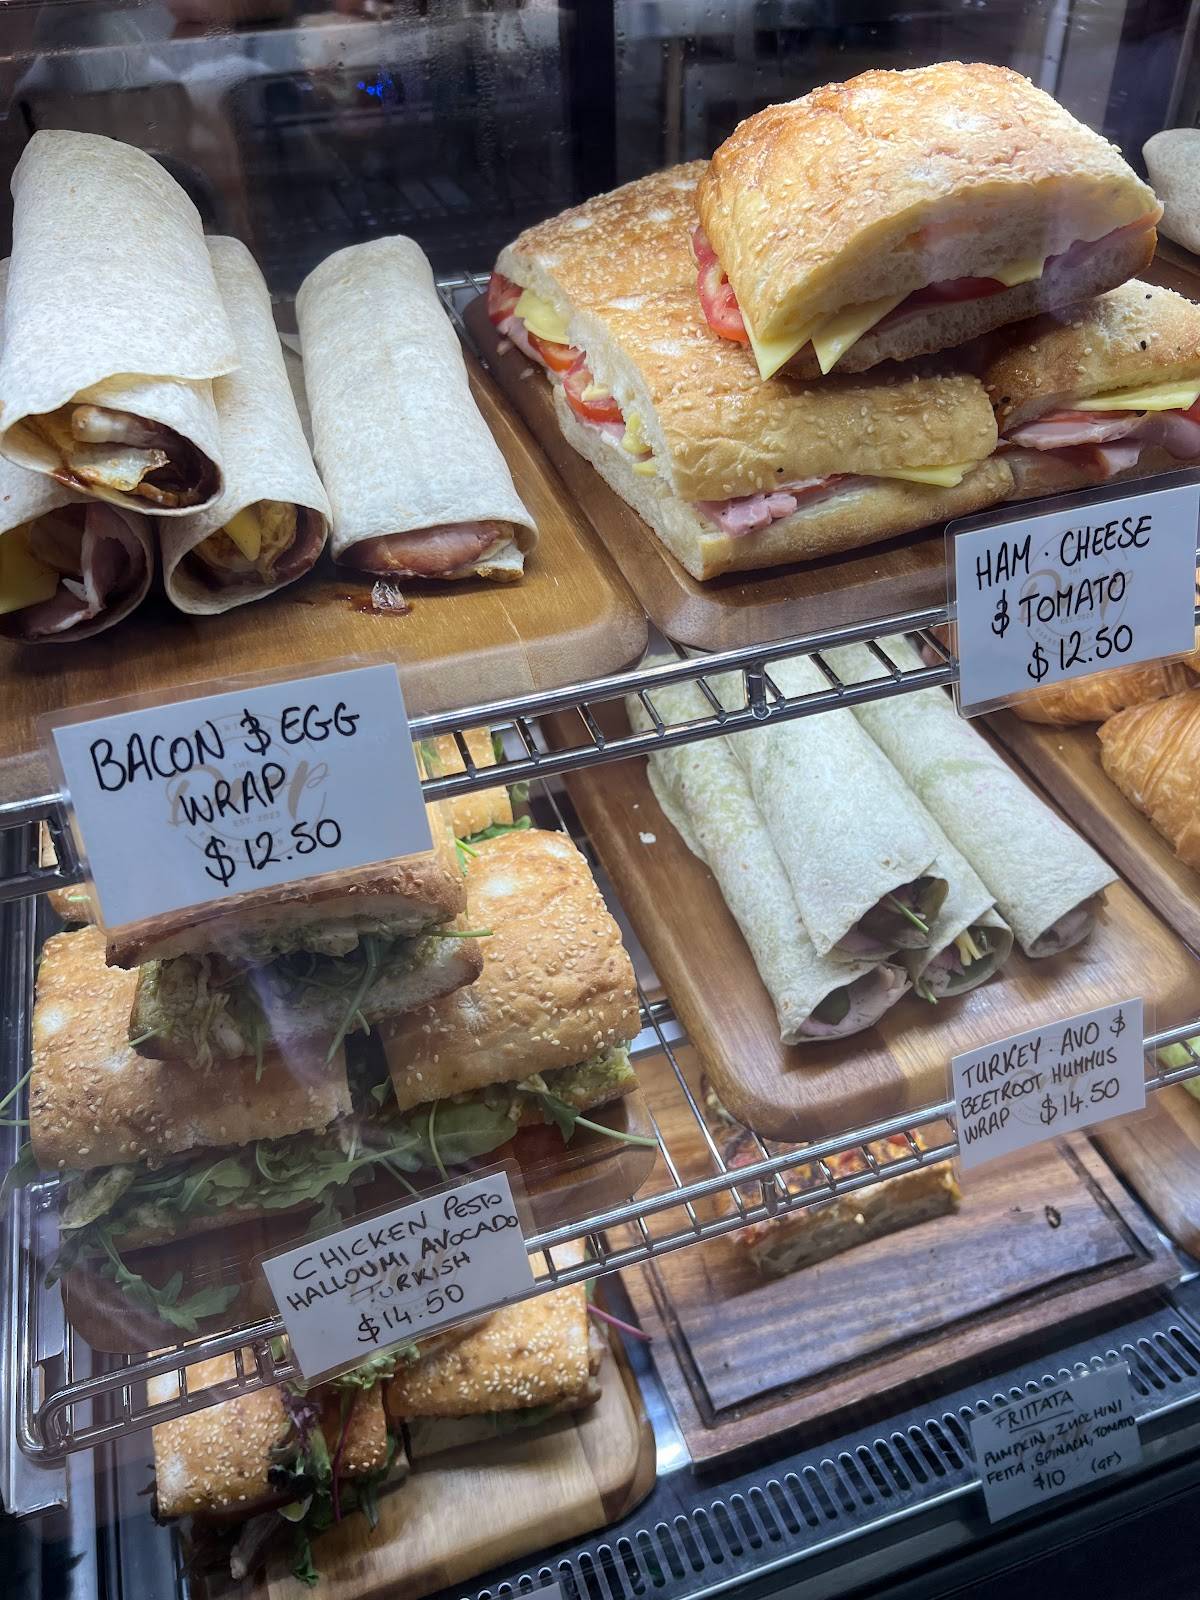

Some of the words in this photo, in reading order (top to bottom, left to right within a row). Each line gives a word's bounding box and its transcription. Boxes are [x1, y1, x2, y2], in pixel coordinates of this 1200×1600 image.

[976, 534, 1031, 591] HAM
[1060, 515, 1152, 567] CHEESE
[1018, 571, 1126, 627] TOMATO
[1027, 624, 1133, 683] $12.50
[90, 720, 225, 792] BACON
[281, 702, 360, 745] EGG
[179, 762, 286, 826] WRAP
[204, 818, 342, 887] $12.50
[960, 1072, 1043, 1119] BEETROOT
[1051, 1046, 1118, 1084] HUMMUS
[961, 1036, 1041, 1088] TURKEY
[1060, 1022, 1100, 1055] AVO
[964, 1107, 1010, 1144] WRAP
[1039, 1077, 1120, 1125] $14.50
[286, 1252, 408, 1311] HALLOUMI
[421, 1214, 519, 1259] AVOCADO
[293, 1211, 427, 1280] CHICKEN
[350, 1250, 471, 1303] TURKISH
[357, 1284, 464, 1344] $14.50
[992, 1390, 1074, 1429] FRITTATA
[1055, 1399, 1123, 1436] ZUCCHINI
[1092, 1415, 1135, 1438] TOMATO
[1033, 1469, 1066, 1490] $10
[1090, 1451, 1122, 1474] (GF)
